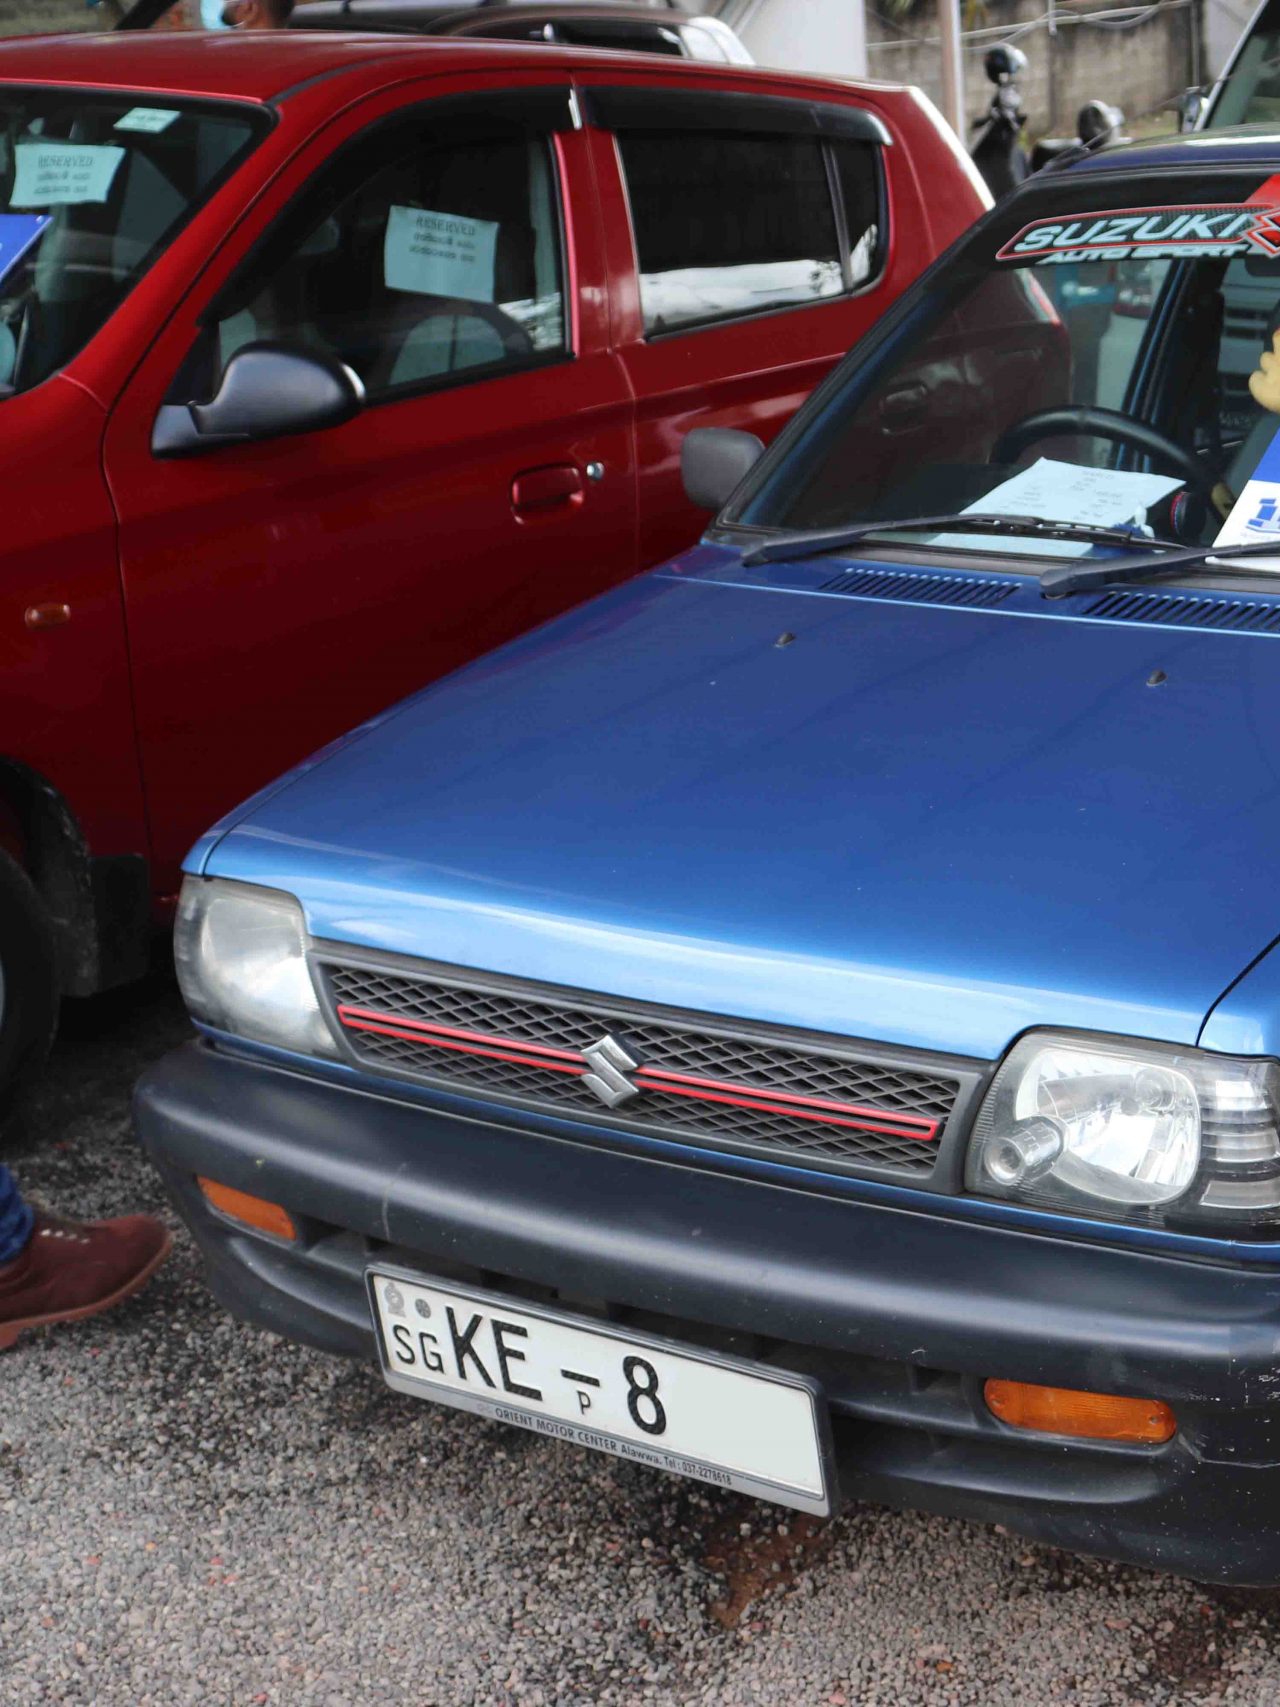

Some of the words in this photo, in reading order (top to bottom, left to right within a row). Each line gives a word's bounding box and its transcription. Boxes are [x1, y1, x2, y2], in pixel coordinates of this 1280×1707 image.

[416, 216, 476, 236] RESERVED
[1014, 212, 1252, 253] SUZUKI
[1034, 247, 1131, 265] AUTO
[1131, 244, 1249, 260] SPORT
[392, 1324, 445, 1374] SG
[577, 1390, 591, 1415] P
[495, 1406, 533, 1427] ORIENT
[536, 1419, 576, 1440] MOTOR
[577, 1430, 618, 1452] CENTER
